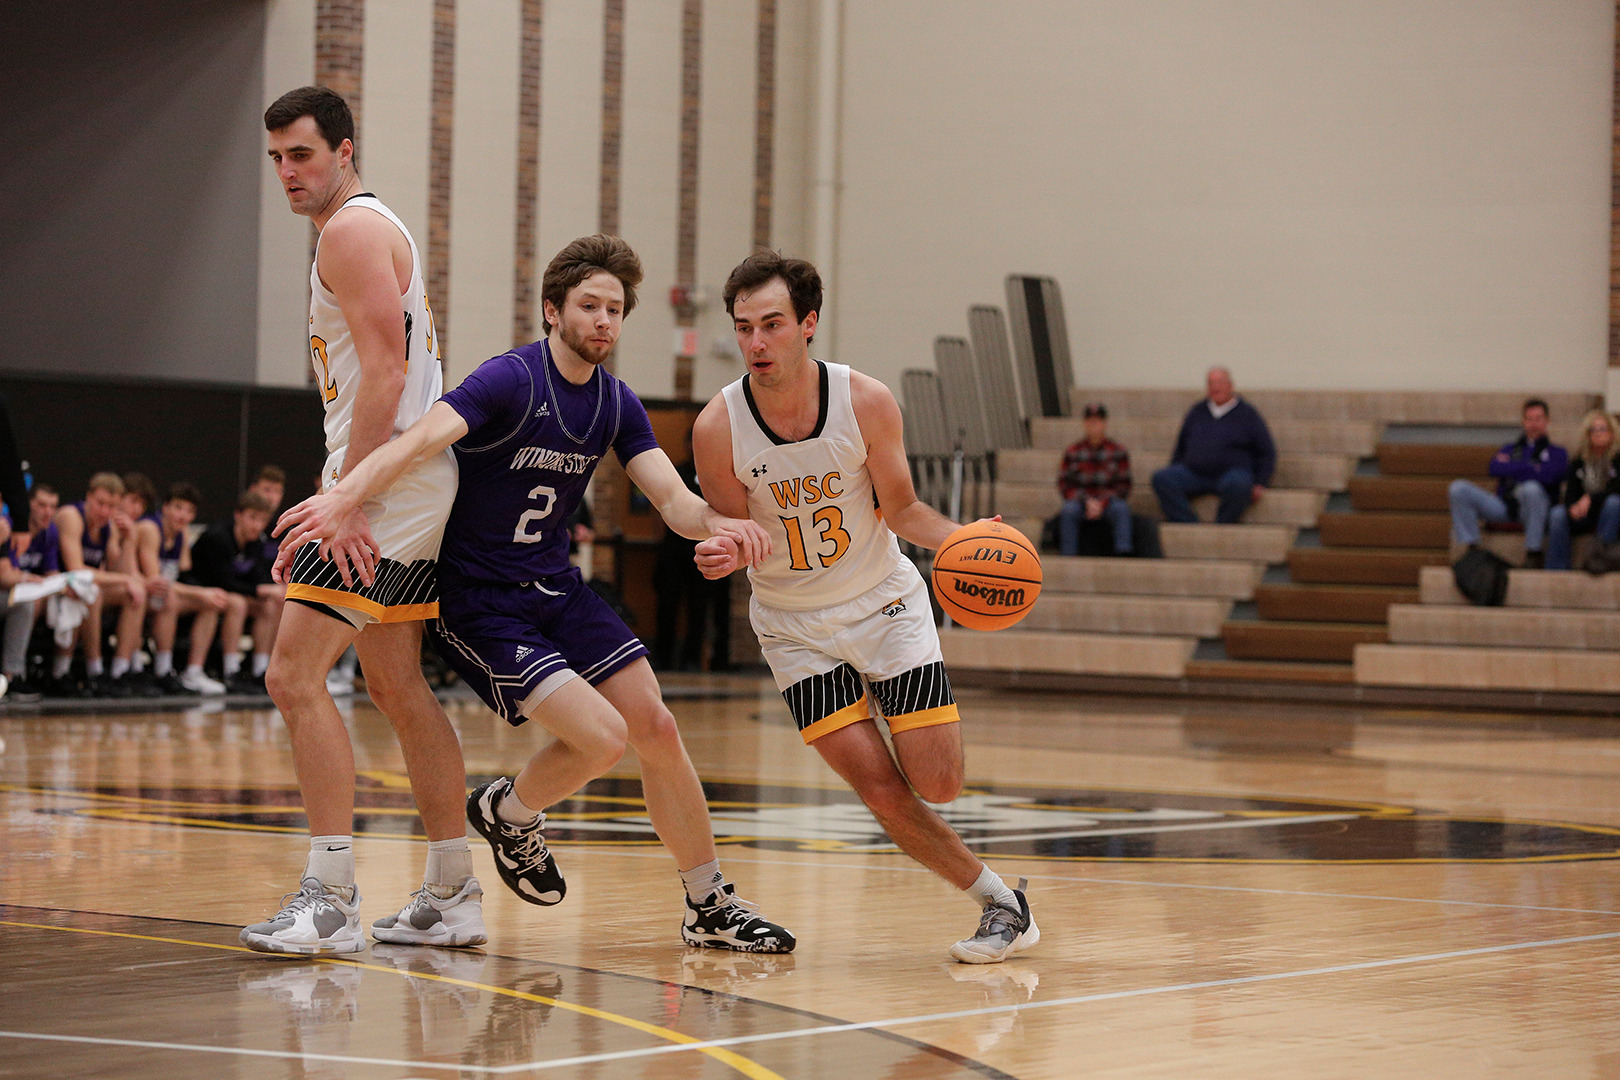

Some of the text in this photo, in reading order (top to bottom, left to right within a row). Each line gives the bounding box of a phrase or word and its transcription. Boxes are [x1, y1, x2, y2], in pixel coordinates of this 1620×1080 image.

[768, 471, 844, 510] WSC
[512, 485, 557, 544] 2
[778, 505, 851, 571] 13
[973, 548, 1017, 565] EVO
[955, 578, 1025, 607] Wilson
